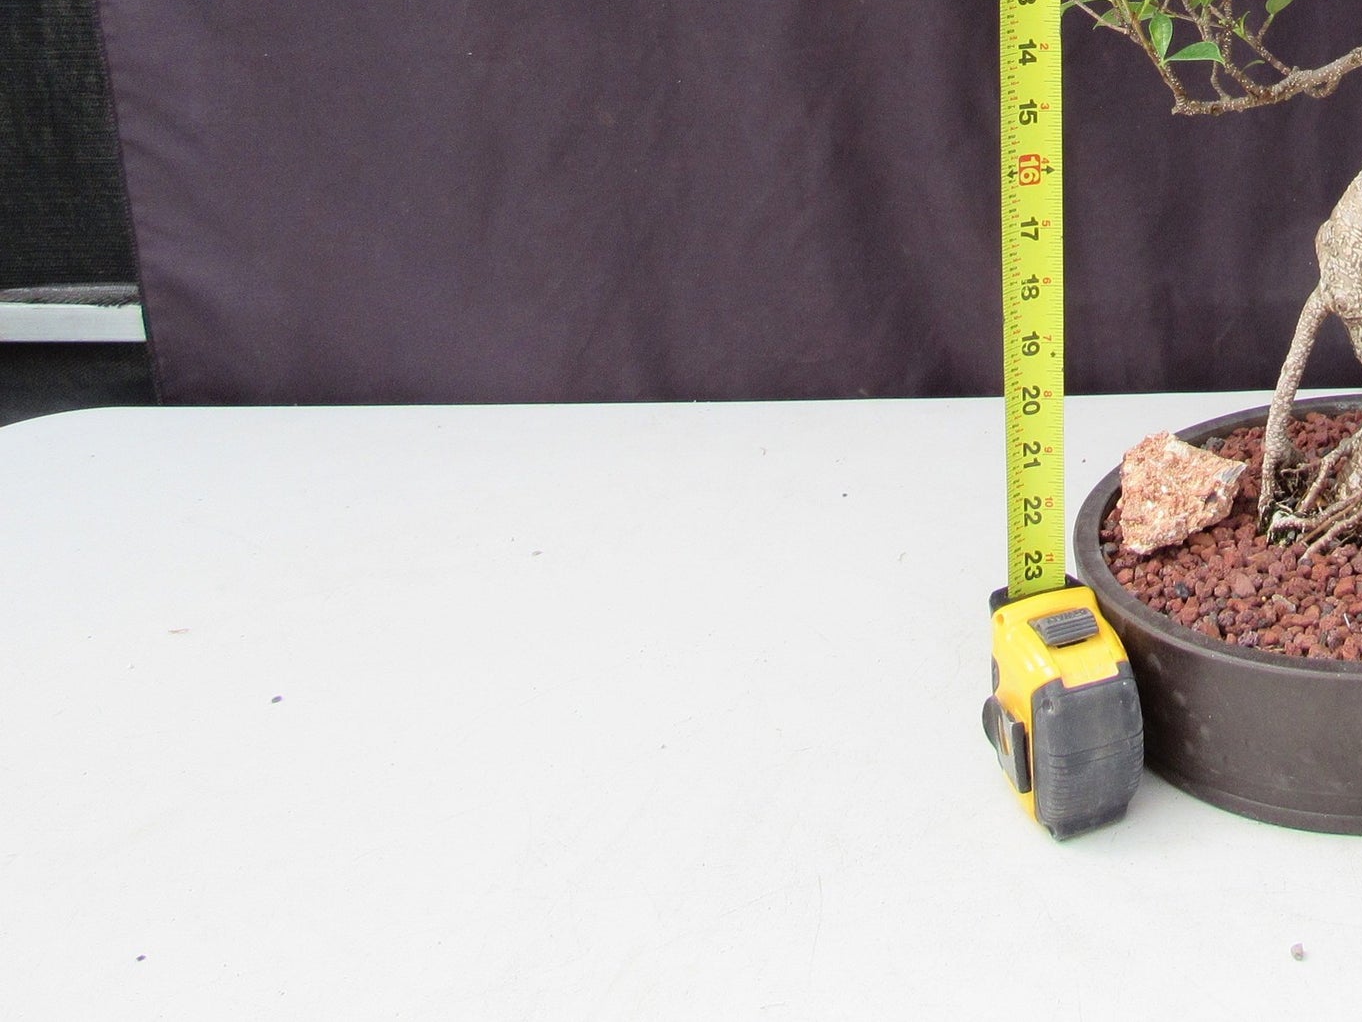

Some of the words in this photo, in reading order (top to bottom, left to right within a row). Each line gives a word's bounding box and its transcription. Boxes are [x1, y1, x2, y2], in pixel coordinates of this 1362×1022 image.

[1019, 40, 1037, 66] 14
[1019, 99, 1037, 125] 15
[1020, 157, 1039, 184] 16
[1020, 217, 1039, 241] 17
[1021, 274, 1040, 300] 18
[1022, 331, 1040, 356] 19
[1023, 386, 1040, 415] 20
[1023, 442, 1041, 468] 21
[1024, 497, 1042, 526] 22
[1045, 497, 1053, 508] 10
[1024, 550, 1042, 581] 23
[1045, 552, 1054, 563] 11
